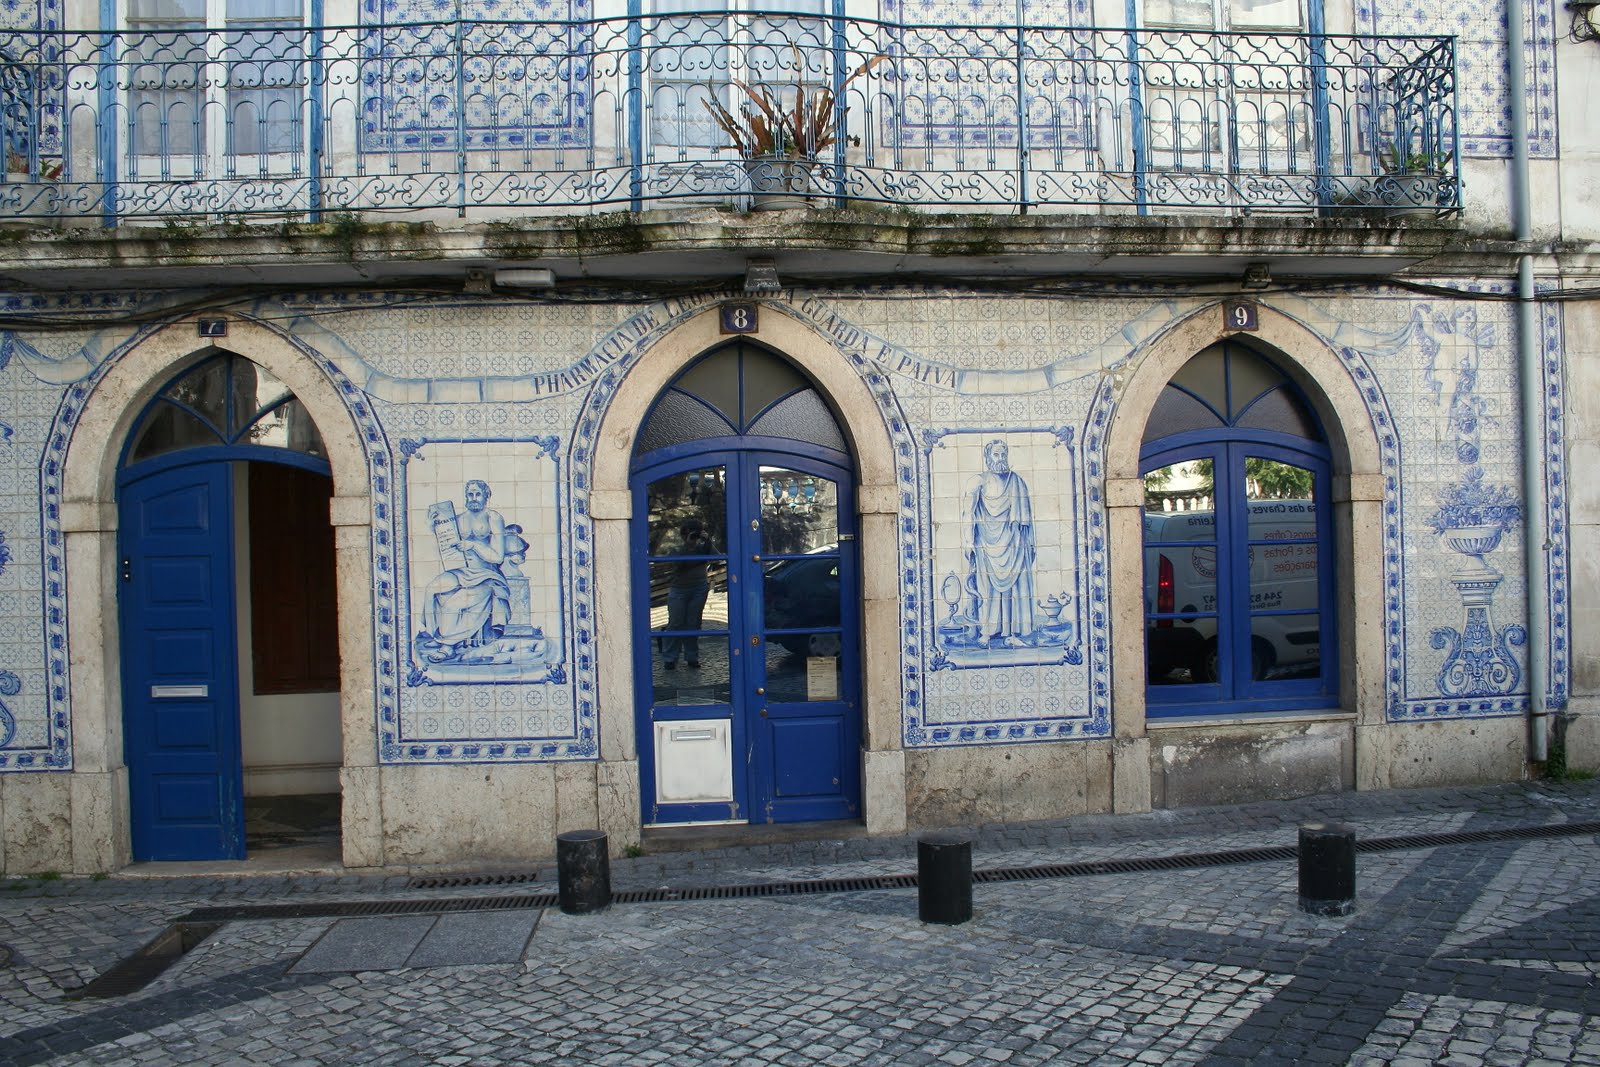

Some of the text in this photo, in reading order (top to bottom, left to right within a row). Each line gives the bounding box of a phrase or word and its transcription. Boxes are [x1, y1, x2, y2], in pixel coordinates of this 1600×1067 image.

[734, 308, 748, 329] 8
[1235, 306, 1248, 326] 9
[534, 331, 633, 395] PHARMACIA
[632, 309, 661, 337] DE
[801, 297, 870, 353] GUARDA
[877, 344, 892, 363] E
[896, 355, 957, 389] PAIVA
